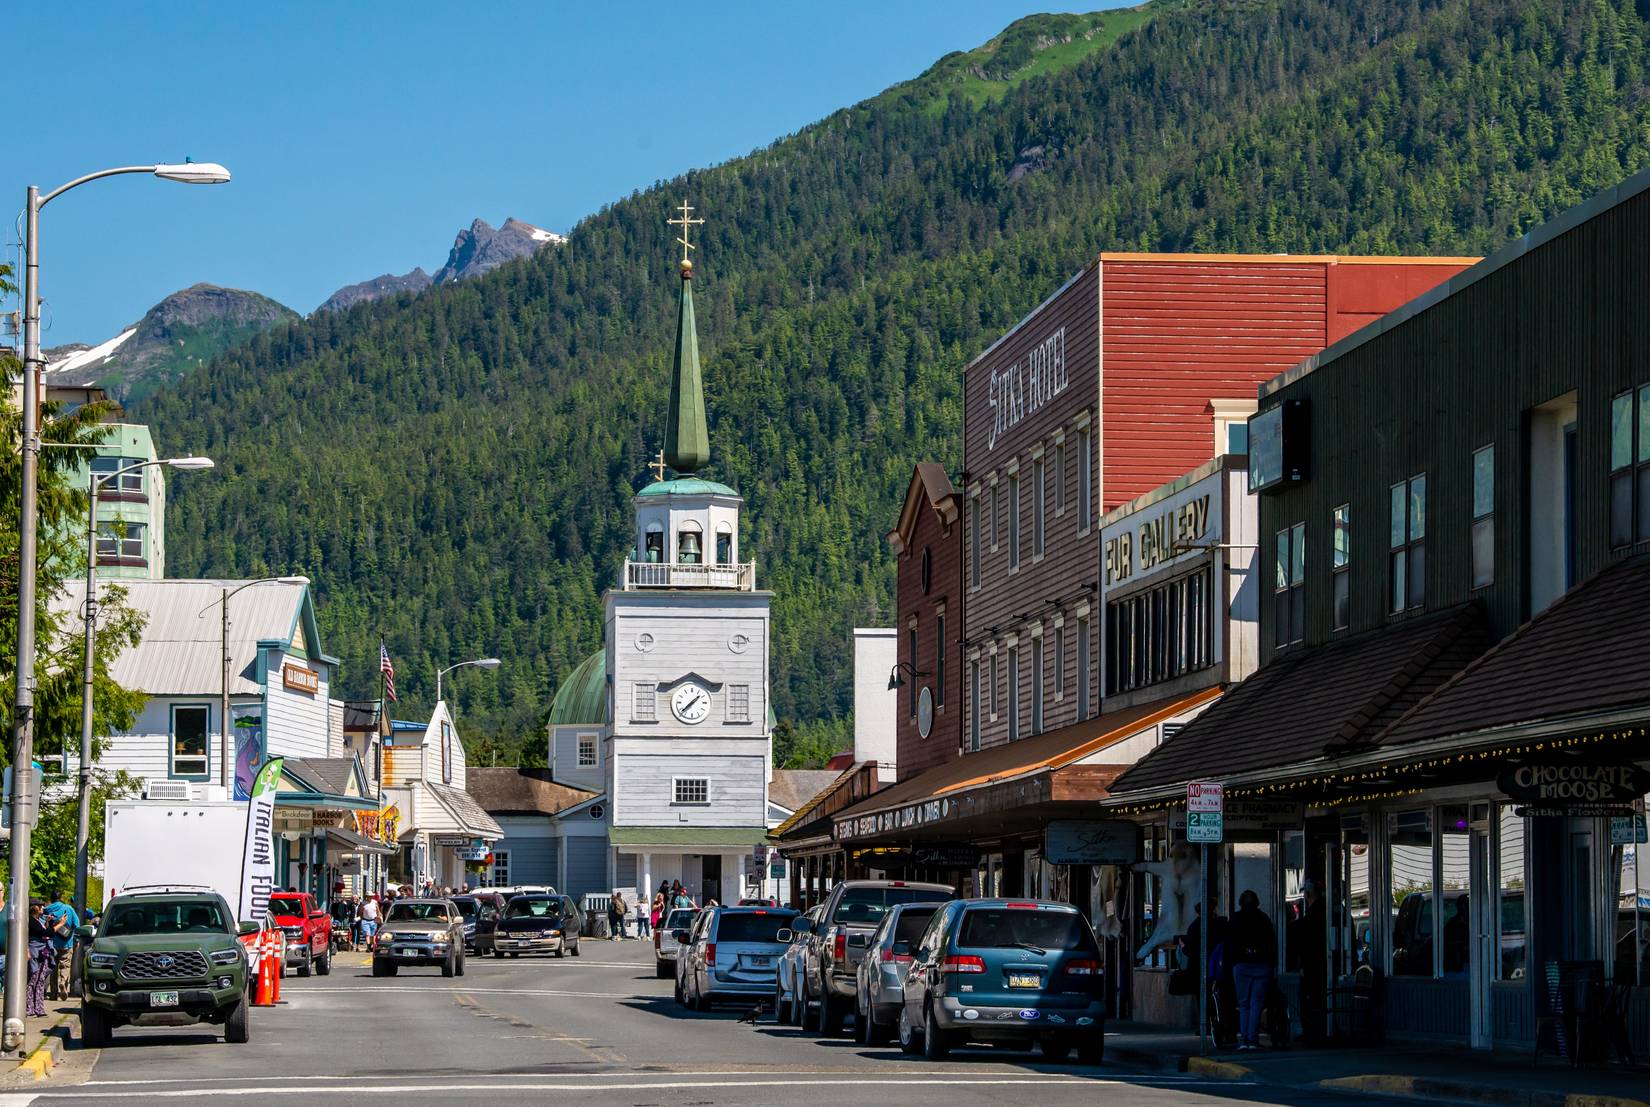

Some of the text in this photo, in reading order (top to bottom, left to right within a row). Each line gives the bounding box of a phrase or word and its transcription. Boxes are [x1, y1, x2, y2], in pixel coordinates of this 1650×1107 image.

[988, 327, 1069, 450] SITKA HOTEL
[1105, 495, 1210, 585] FUR GALLERY
[1514, 766, 1636, 792] CHOCOLATE
[1190, 784, 1221, 797] NO PARKING
[1539, 780, 1616, 801] MOOSE
[1190, 813, 1199, 825] 2
[1242, 804, 1297, 814] PHARMACY
[1525, 807, 1564, 816] Sitka
[250, 801, 273, 920] ITALIAN FOOD
